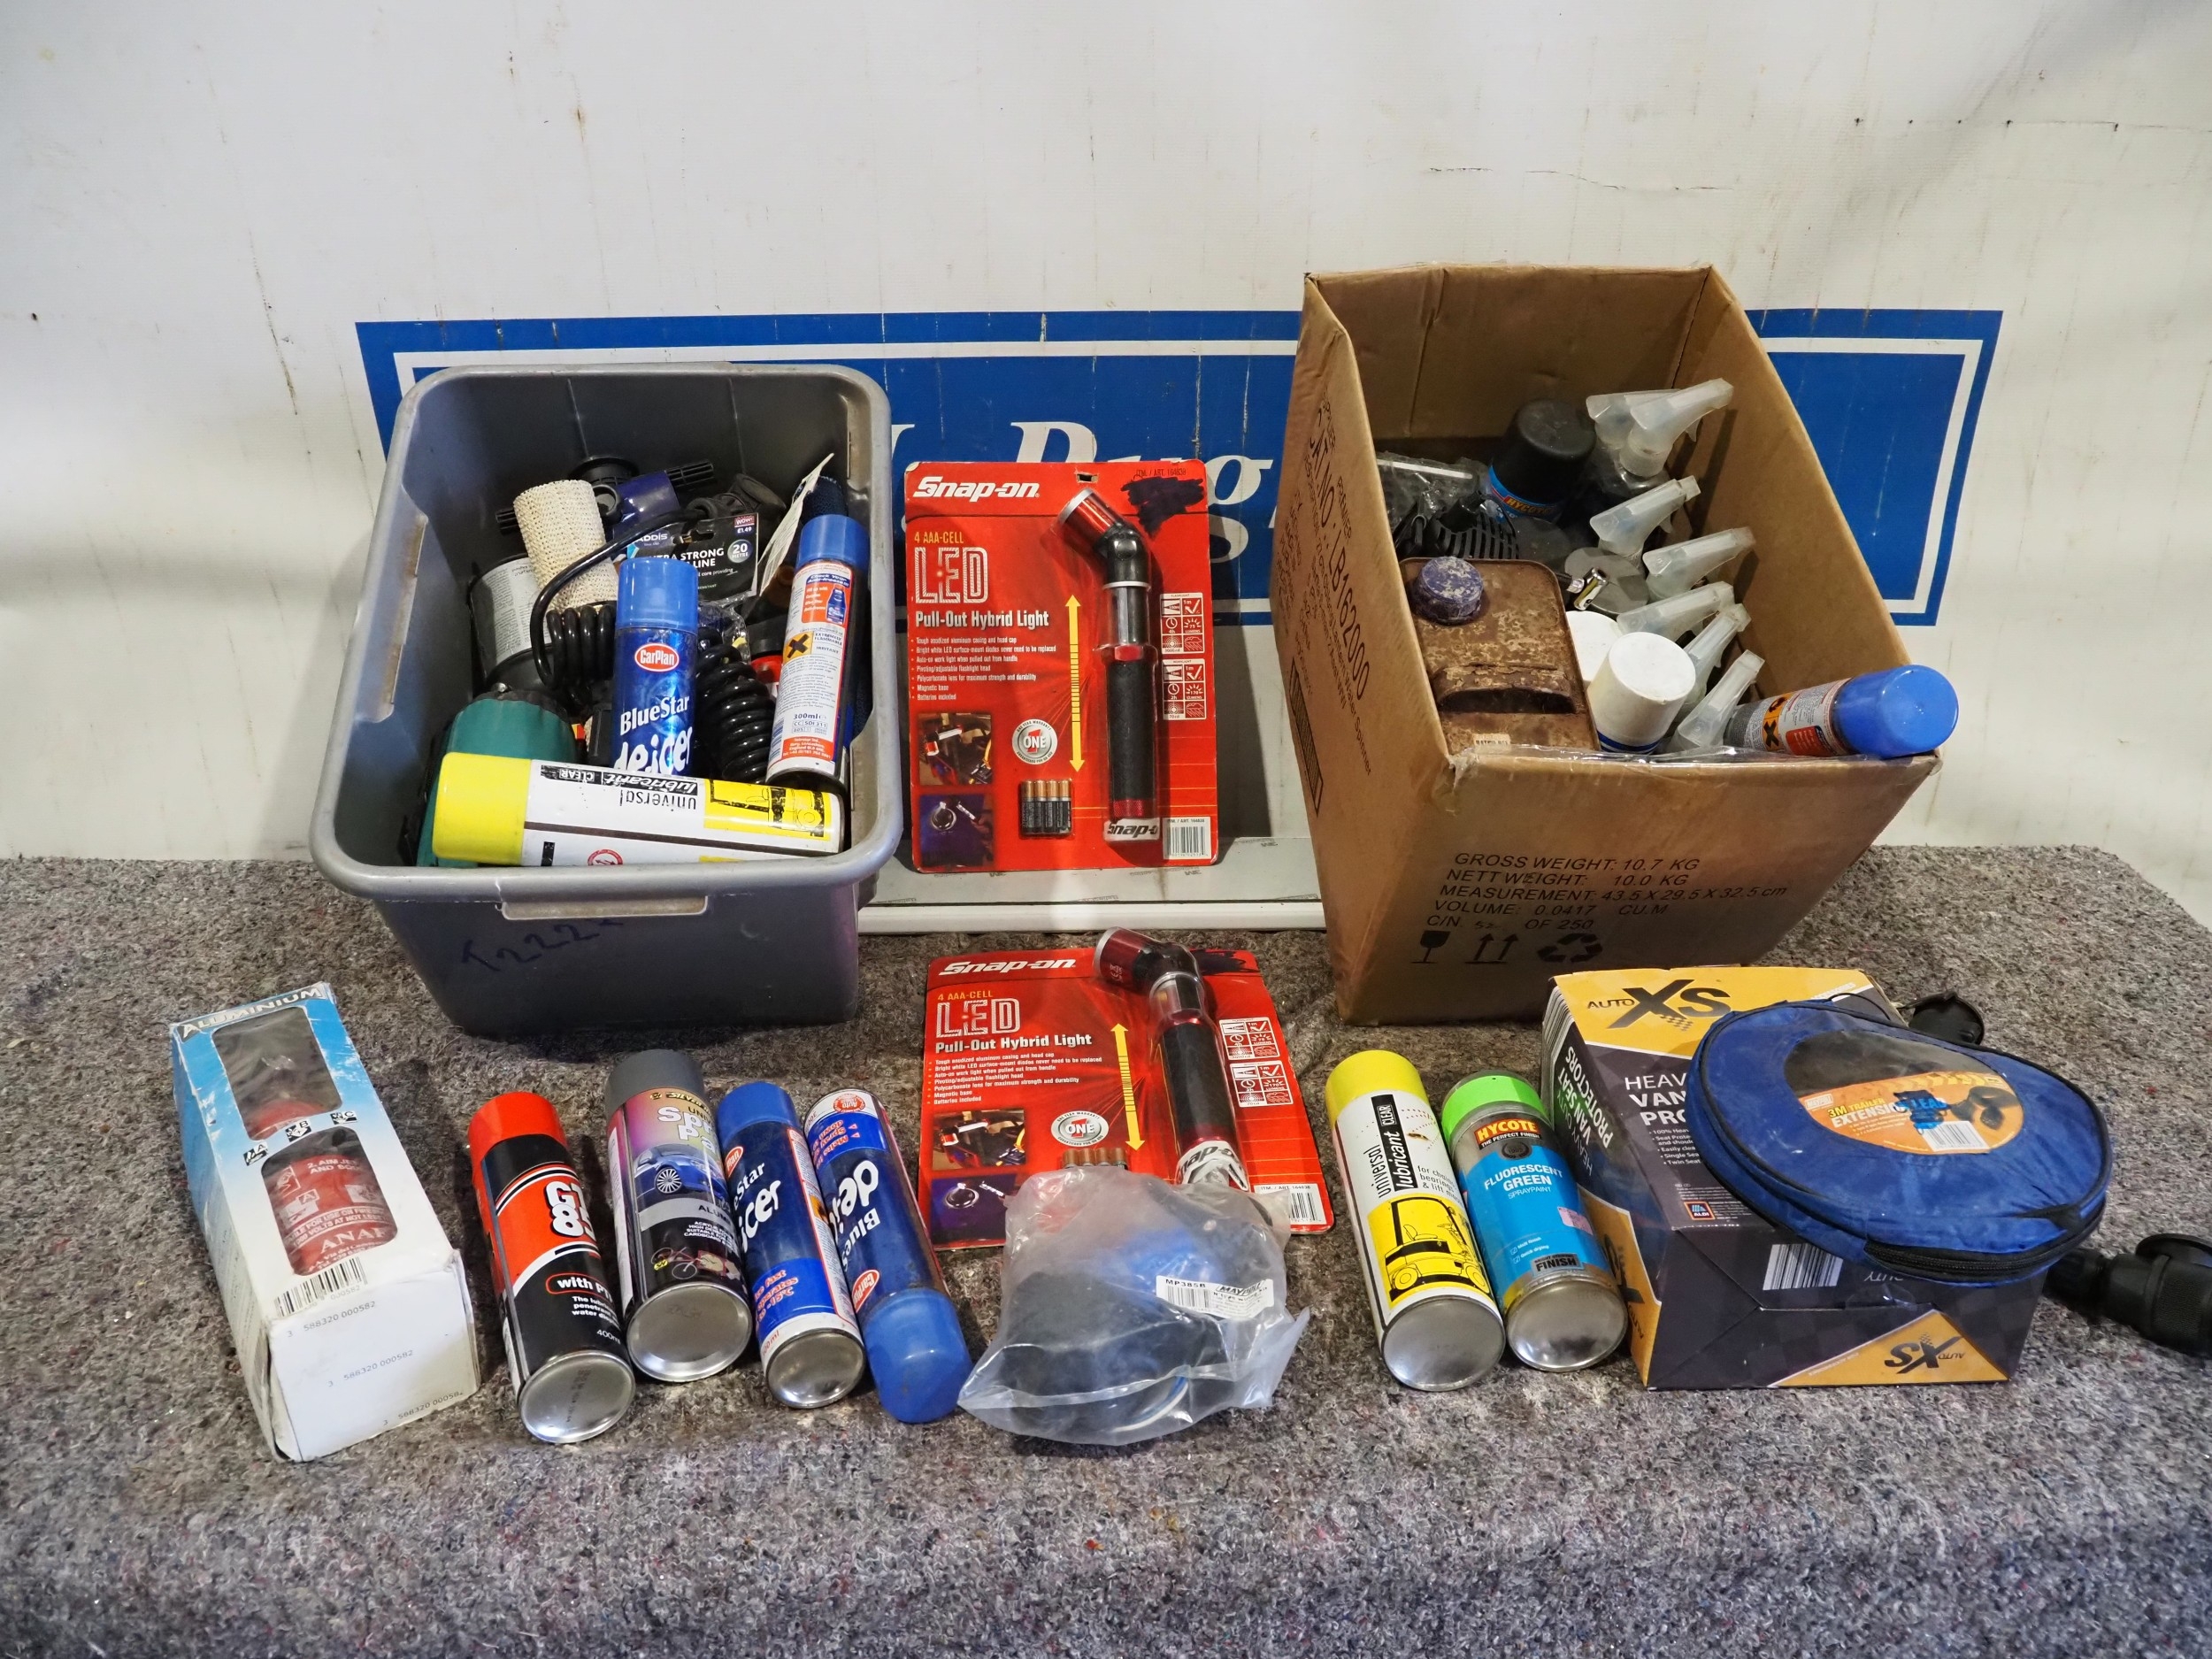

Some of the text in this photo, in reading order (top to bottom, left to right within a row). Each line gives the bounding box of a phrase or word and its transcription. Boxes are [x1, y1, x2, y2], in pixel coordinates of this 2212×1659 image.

[913, 476, 1039, 502] Snap-on
[914, 531, 964, 543] 4 AAA-CELL
[680, 548, 724, 559] STRONG
[733, 543, 748, 552] 20
[695, 558, 716, 568] LINE
[915, 547, 988, 603] LED
[916, 611, 1048, 630] Pull-Out Hybrid Light
[1329, 529, 1369, 700] LB162000
[814, 637, 842, 646] FLAMMABLE
[640, 649, 675, 665] CarPlan
[620, 695, 690, 736] BlueStar
[1024, 736, 1046, 749] ONE
[1355, 716, 1371, 776] Spinner
[560, 770, 698, 795] lubricant CLEAR
[619, 789, 697, 812] universal
[1455, 853, 1700, 872] GROSS WEIGHT: 10.7 KG
[1447, 869, 1689, 886] NETT WEIGHT: 10.0 KG
[1440, 885, 1788, 902] MEASUREMENT: 43.5 X 29.5 X 32.5 cm
[1434, 900, 1670, 916] VOLUME: 0.0417 CU.M
[1525, 918, 1554, 930] OF
[1556, 918, 1594, 931] 250
[939, 959, 1075, 975] Snap-on
[948, 991, 993, 1000] AAA-CELL
[1586, 979, 1732, 1029] AUTO XS
[182, 987, 322, 1039] ALUMINIUM
[936, 998, 1020, 1038] LED
[936, 1034, 1092, 1053] Pull-Out Hybrid Light
[1557, 1067, 1592, 1146] VAN SEAT
[1565, 1046, 1614, 1148] PROTECTORS
[1629, 1091, 1686, 1108] VAN
[1828, 1097, 1886, 1118] 3M TRAILER
[821, 1127, 846, 1148] Spray
[1065, 1124, 1094, 1133] ONE
[1477, 1120, 1538, 1141] HYCOTE
[1493, 1133, 1518, 1141] PERFECT
[823, 1135, 849, 1156] Melts
[1379, 1105, 1414, 1188] lubricant CLEAR
[1572, 1126, 1592, 1176] HEAVY
[1363, 1144, 1391, 1198] universal
[1484, 1164, 1563, 1189] FLUORESCENT
[1432, 1182, 1444, 1193] lift
[1503, 1175, 1552, 1191] GREEN
[1508, 1187, 1551, 1199] SPRAYPAINT
[307, 1218, 323, 1231] FOR
[323, 1210, 341, 1220] USE
[309, 1221, 334, 1236] VOLTS
[1536, 1258, 1577, 1271] FINISH
[557, 1277, 594, 1291] with
[765, 1270, 787, 1287] fast
[1165, 1279, 1206, 1288] MP385B
[303, 1314, 339, 1332] 588320
[341, 1301, 376, 1318] 000582
[1884, 1335, 1963, 1374] XS
[343, 1363, 378, 1381] 588320
[380, 1350, 413, 1367] 000582
